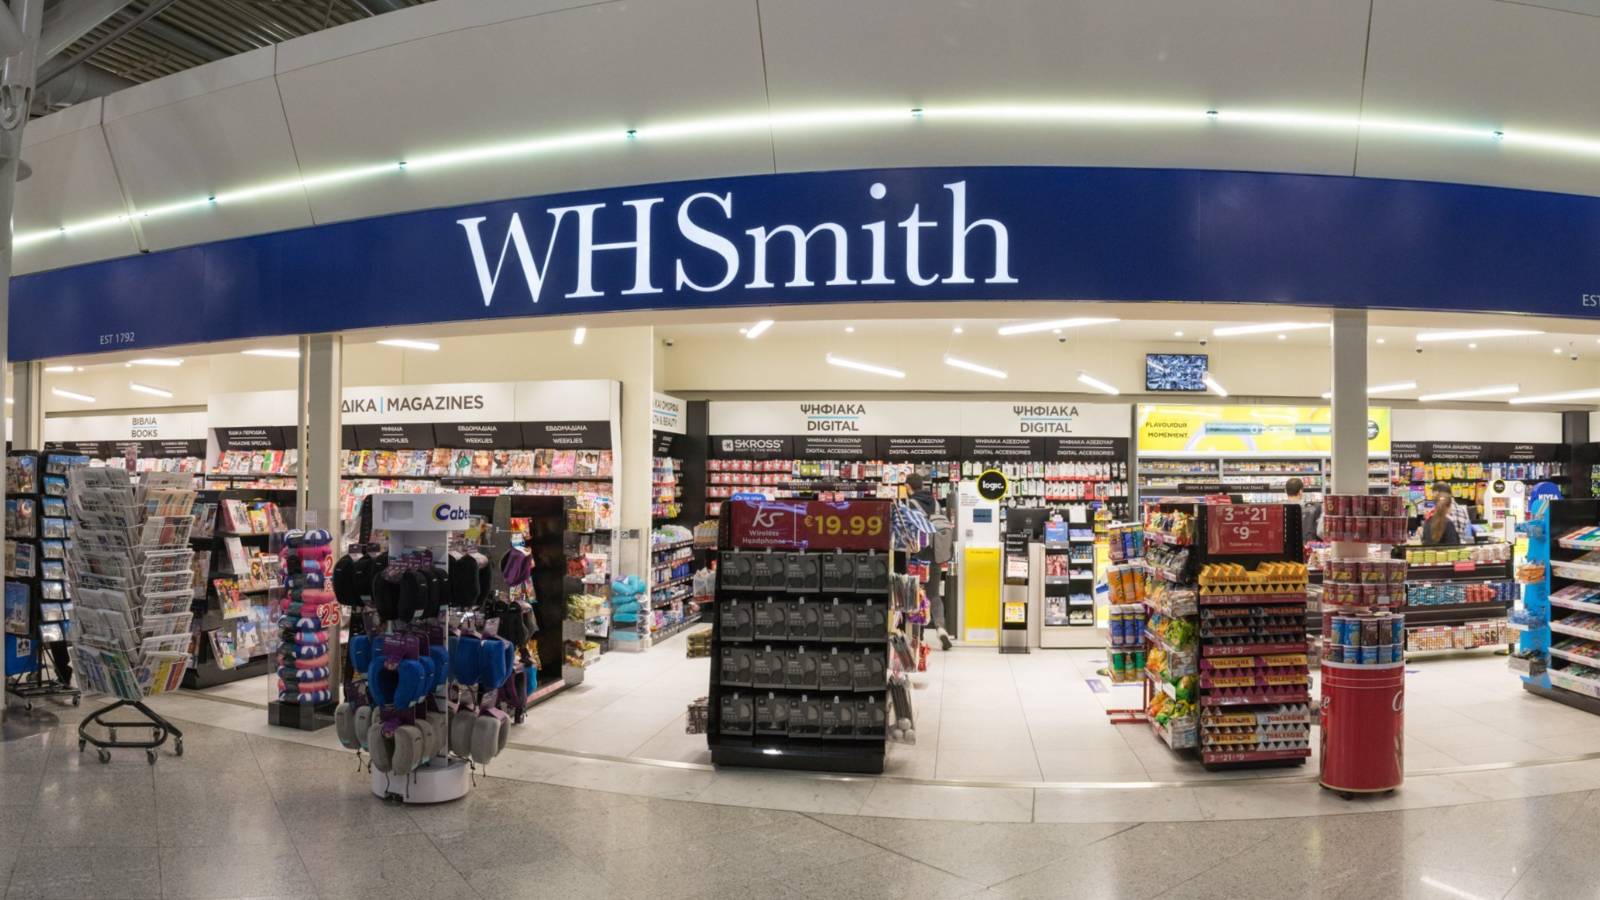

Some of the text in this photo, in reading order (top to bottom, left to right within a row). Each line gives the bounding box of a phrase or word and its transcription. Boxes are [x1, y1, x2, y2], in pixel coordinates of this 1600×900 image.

[456, 180, 1018, 307] WHSmith
[100, 331, 136, 345] EST 1792
[387, 395, 484, 412] MAGAZINES
[800, 403, 866, 415] ΨΗΦΙΑΚΑ
[1013, 405, 1079, 417] ΨΗΦΙΑΚΑ
[131, 417, 158, 426] ΒΙΒΛΙΑ
[807, 420, 859, 431] DIGITAL
[1020, 422, 1073, 433] DIGITAL
[131, 429, 158, 438] BOOKS
[1224, 507, 1234, 521] 3
[804, 515, 882, 536] €19.99
[749, 529, 779, 537] Wireless
